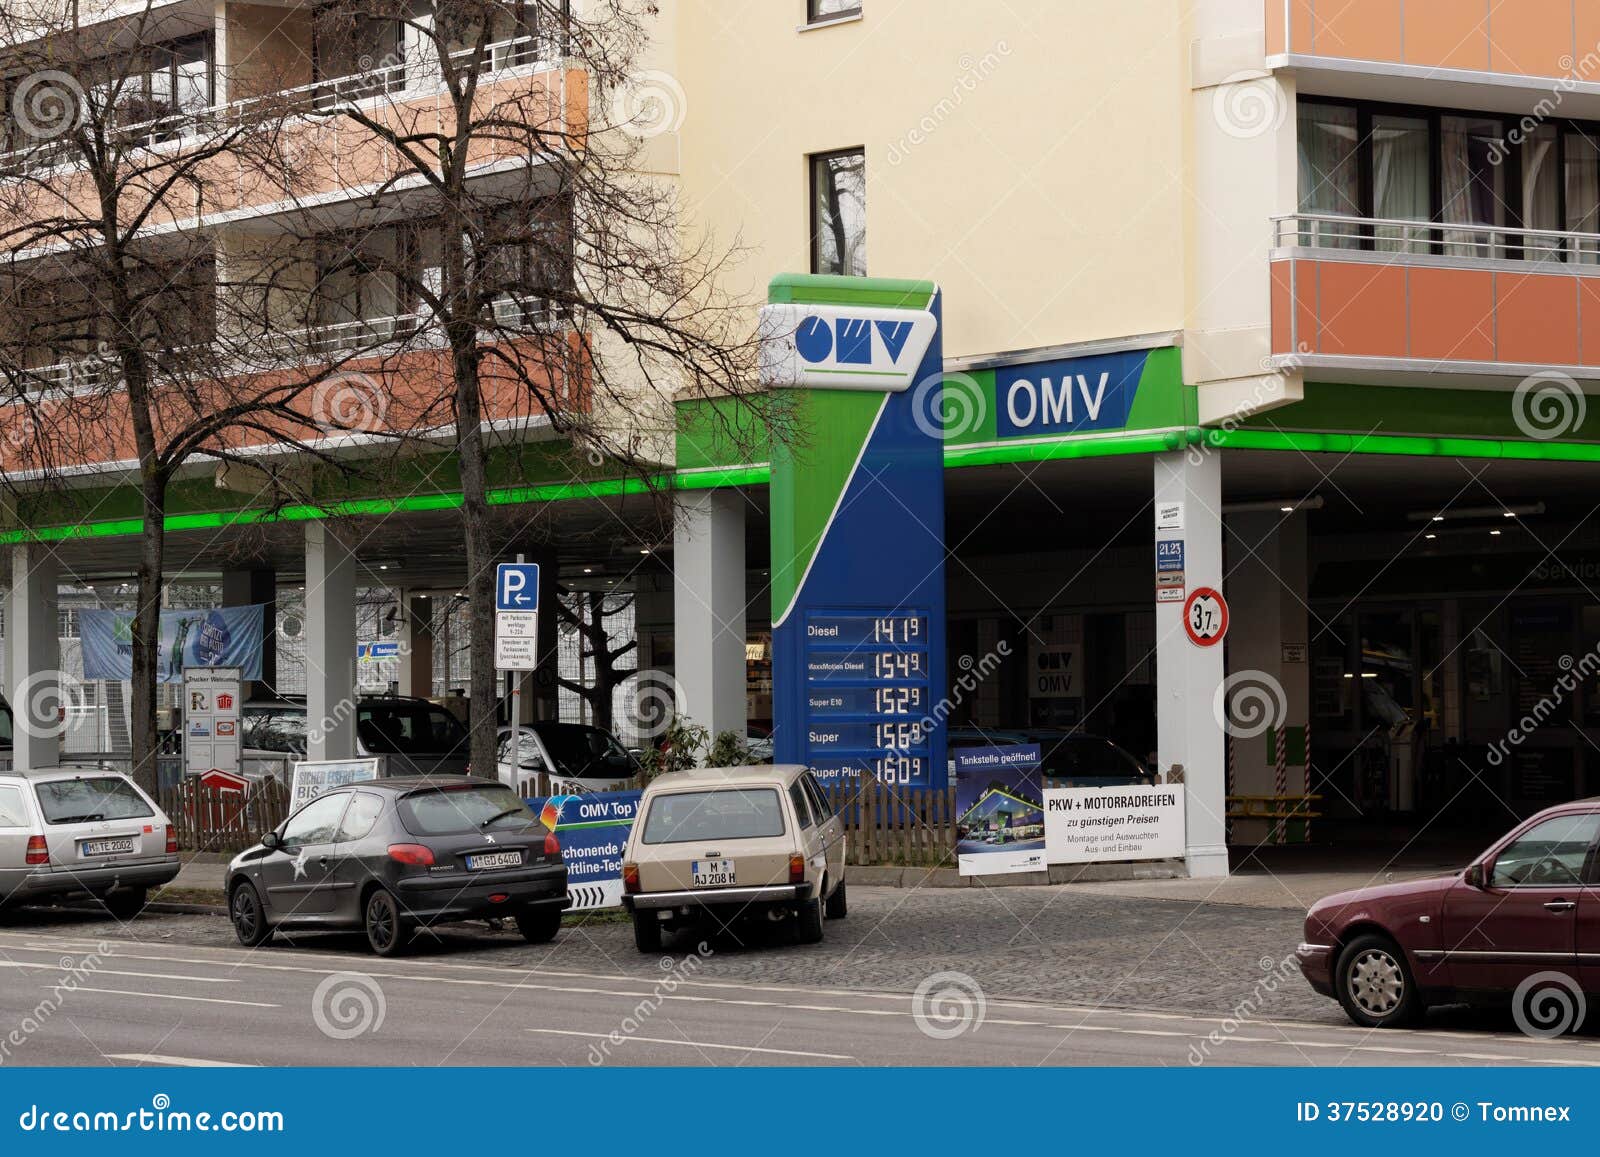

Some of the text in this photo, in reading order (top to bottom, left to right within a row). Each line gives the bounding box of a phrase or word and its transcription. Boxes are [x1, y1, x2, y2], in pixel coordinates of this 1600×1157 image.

[1007, 372, 1110, 428] OMV
[503, 570, 526, 605] P
[807, 625, 839, 637] Diesel
[844, 662, 865, 671] Diesel
[1038, 674, 1072, 693] OMV
[808, 698, 829, 708] Super
[830, 698, 843, 706] E10
[808, 732, 839, 745] Super
[960, 752, 1036, 766] Tankstelle geöffnet!
[809, 766, 840, 780] Super
[298, 785, 319, 799] BIS
[580, 803, 609, 818] OMV
[611, 801, 632, 817] Top
[1048, 798, 1073, 811] PKW
[1084, 794, 1176, 810] MOTORRADREIFEN
[1067, 814, 1159, 829] zu günstigen Preisen
[1067, 831, 1159, 844] Montage und Auswuchten
[89, 840, 132, 852] M TE 2002
[1102, 844, 1116, 853] und
[1118, 842, 1142, 852] Einbau
[471, 855, 479, 867] M
[498, 853, 520, 865] 6400
[710, 863, 718, 872] M
[695, 873, 736, 885] AJ 208 H
